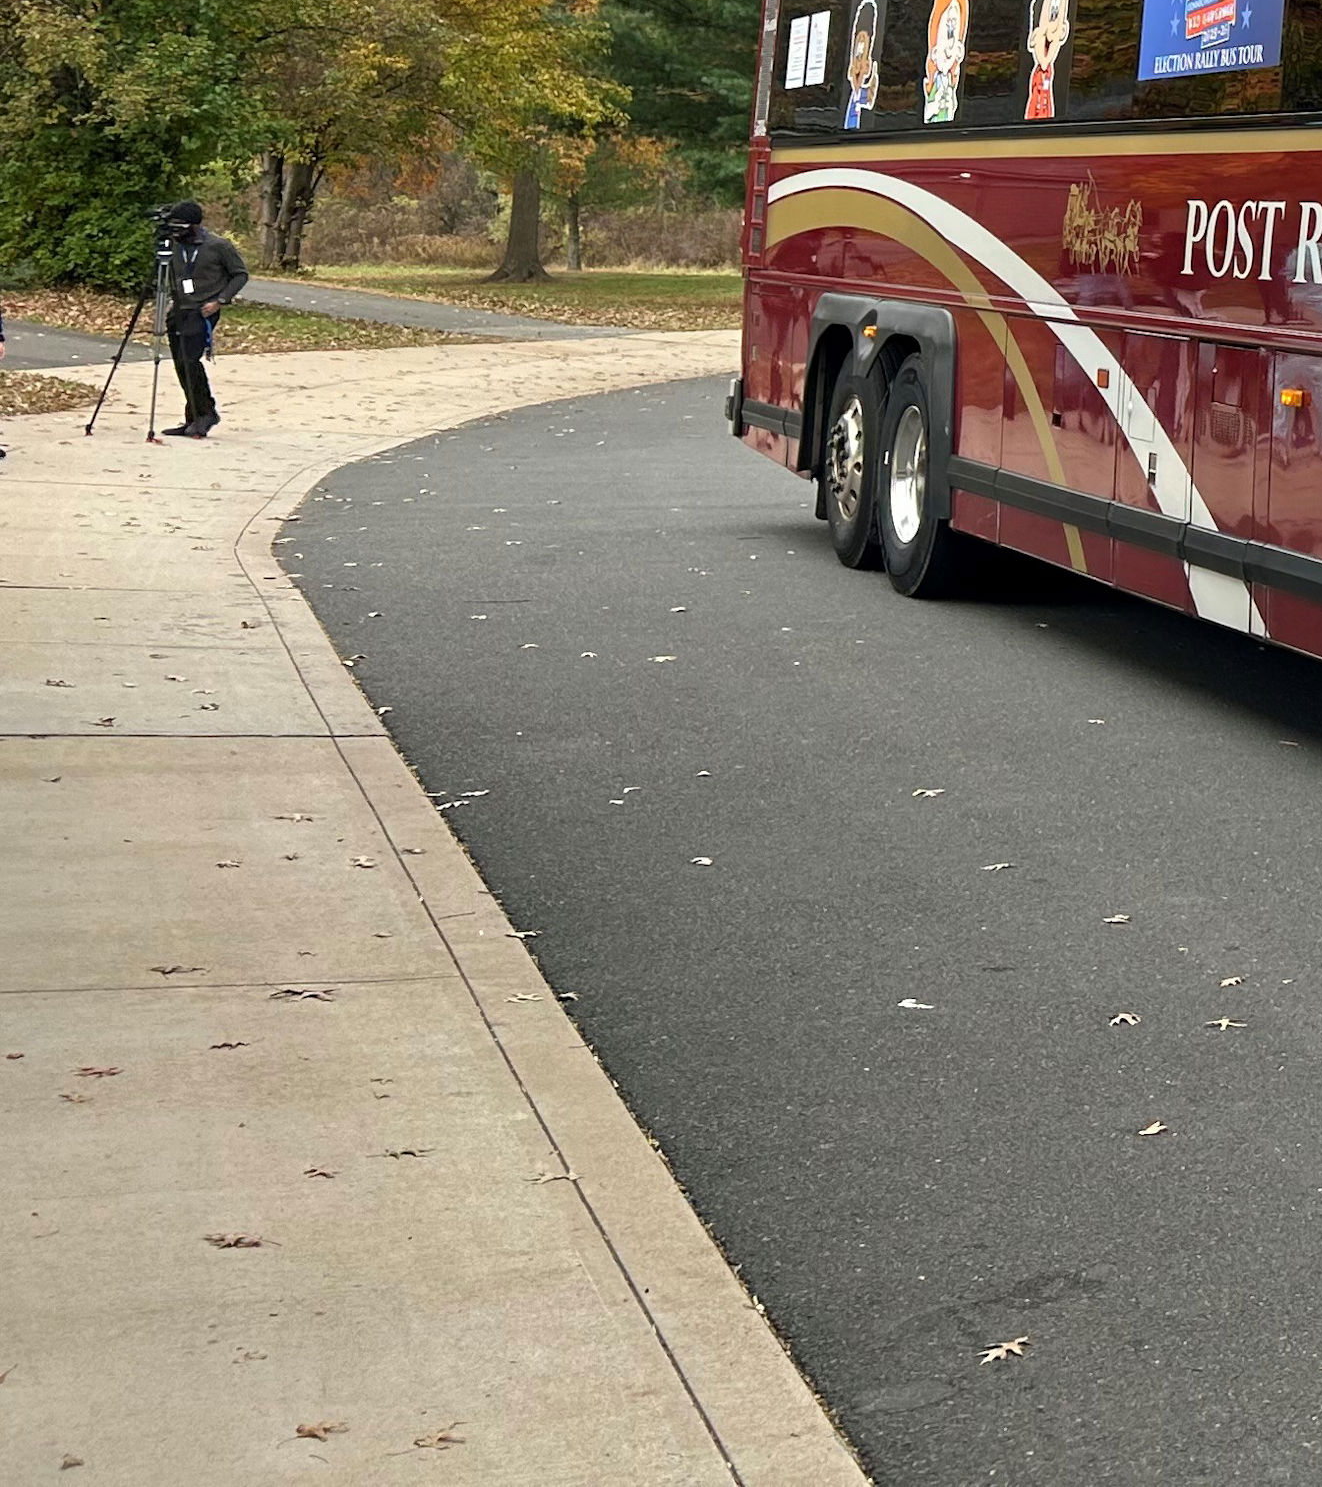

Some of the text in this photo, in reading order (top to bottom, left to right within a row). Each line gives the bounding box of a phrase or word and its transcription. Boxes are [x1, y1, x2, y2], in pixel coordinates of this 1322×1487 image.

[1154, 44, 1264, 74] ELECTION RALLY BUS TOUR
[1180, 199, 1285, 281] POST
